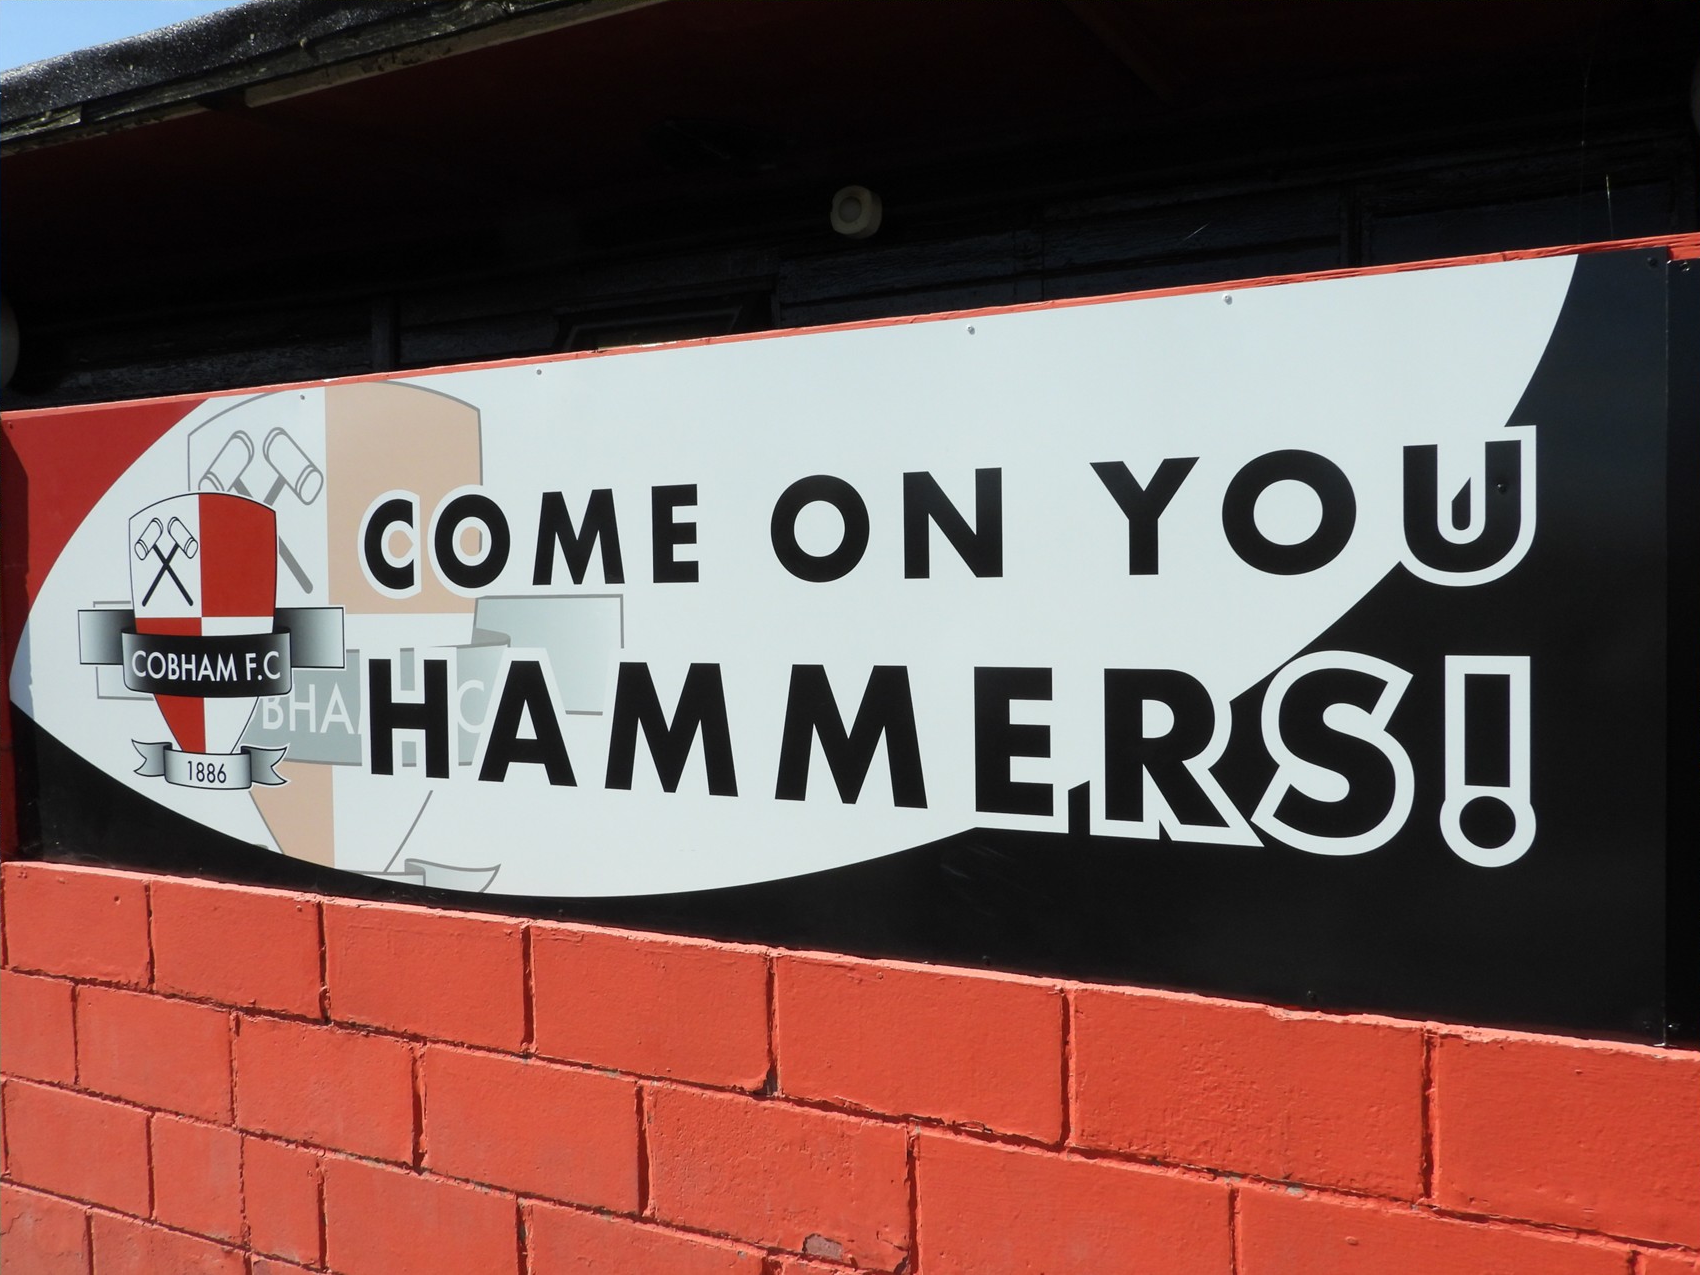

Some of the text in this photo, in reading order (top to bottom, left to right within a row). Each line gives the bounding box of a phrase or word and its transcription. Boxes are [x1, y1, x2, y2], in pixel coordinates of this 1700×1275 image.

[360, 425, 1537, 596] COME ON YOU
[132, 650, 281, 682] COBHAM F.C
[187, 760, 228, 784] 1886
[367, 651, 1537, 867] HAMMERS!
